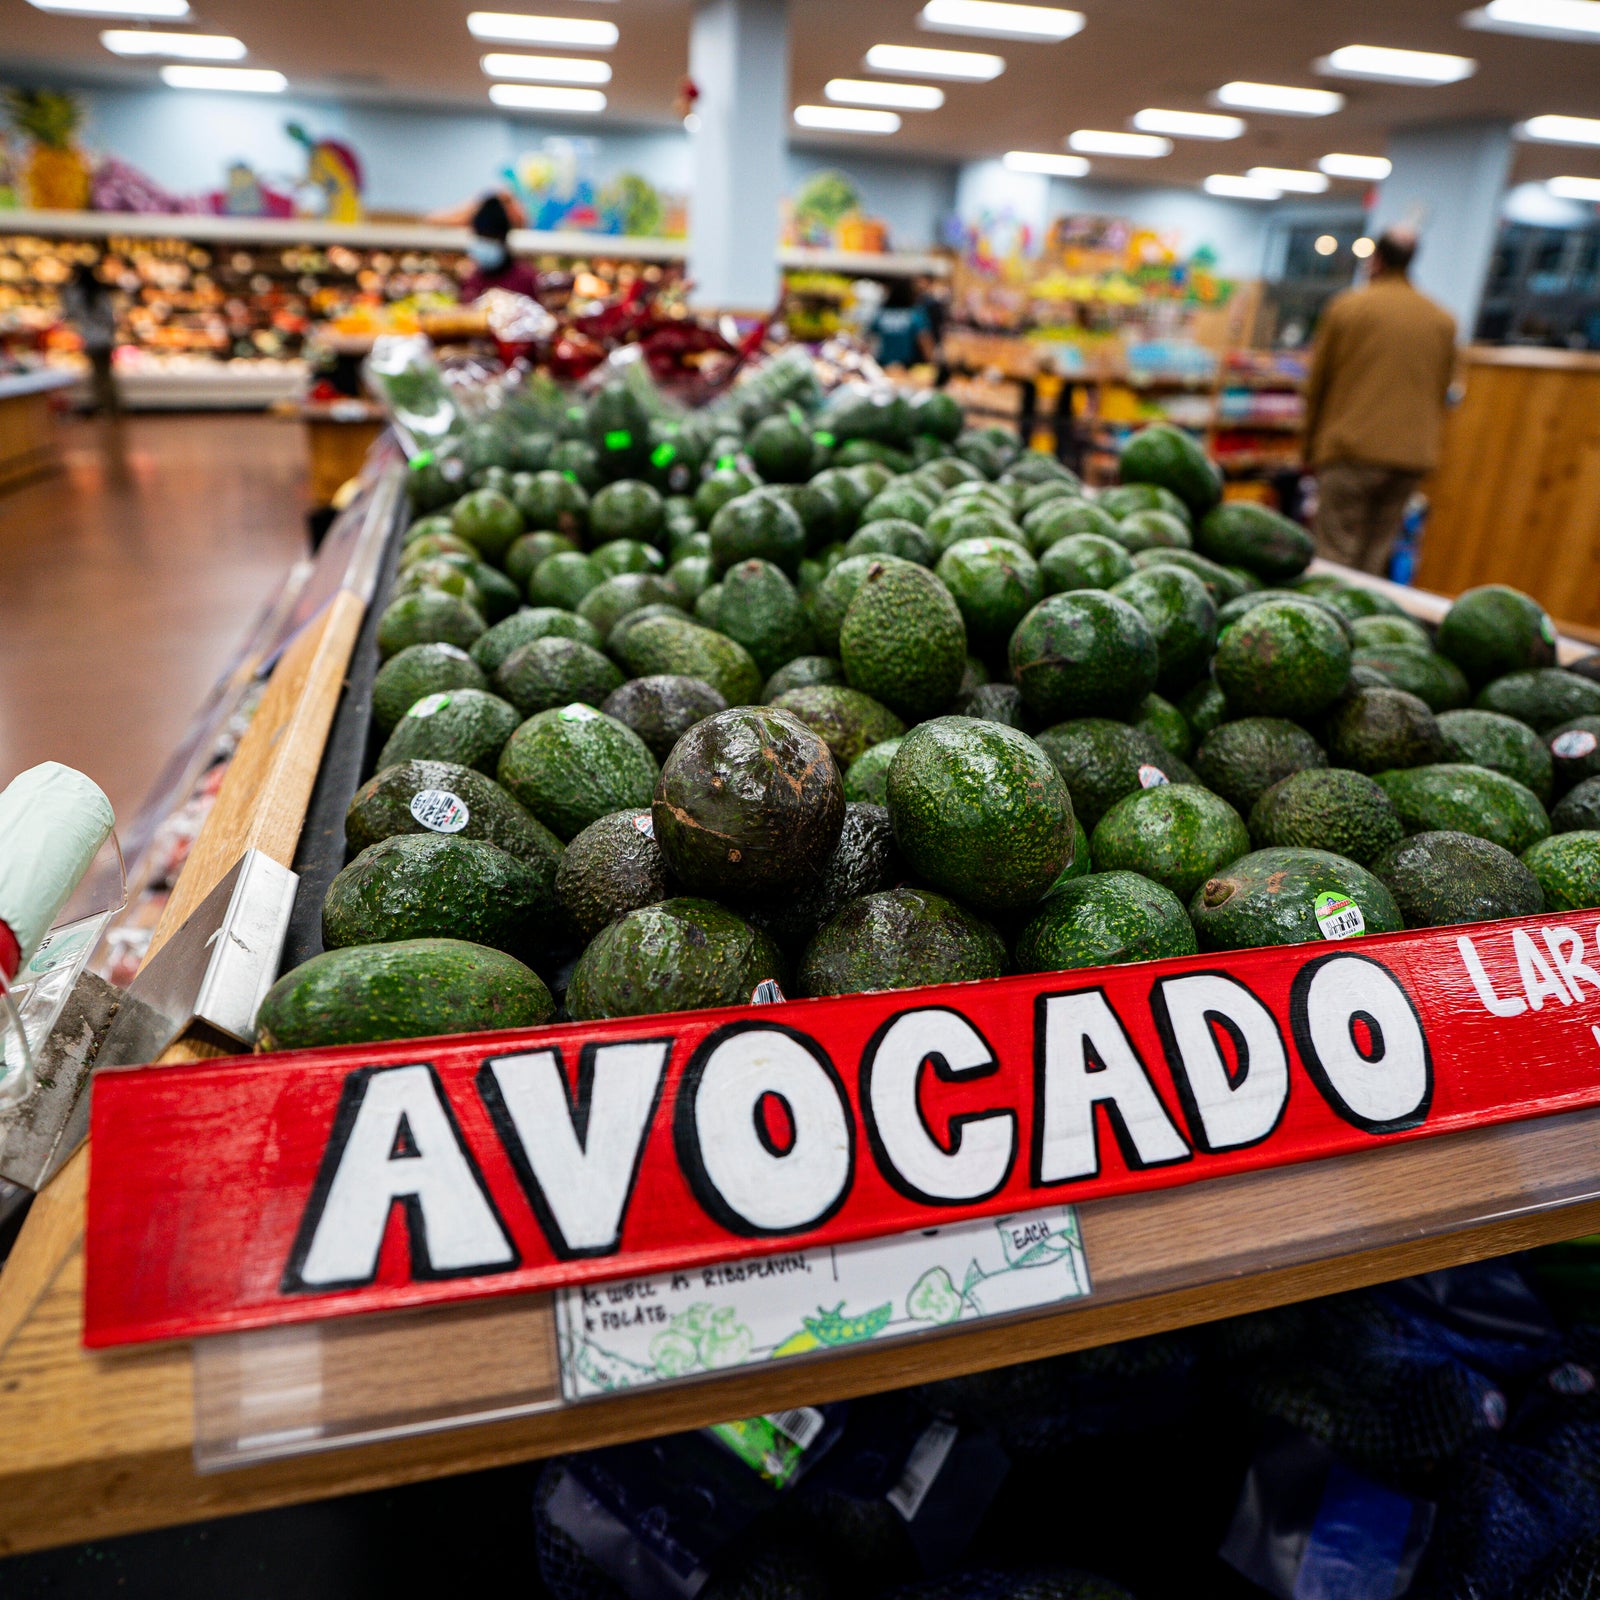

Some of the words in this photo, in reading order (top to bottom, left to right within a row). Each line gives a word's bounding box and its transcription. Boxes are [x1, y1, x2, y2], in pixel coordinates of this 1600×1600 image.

[1456, 922, 1600, 1018] LAR
[282, 950, 1433, 1293] AVOCADO
[1012, 1220, 1050, 1250] EACH
[606, 1281, 656, 1304] WELL
